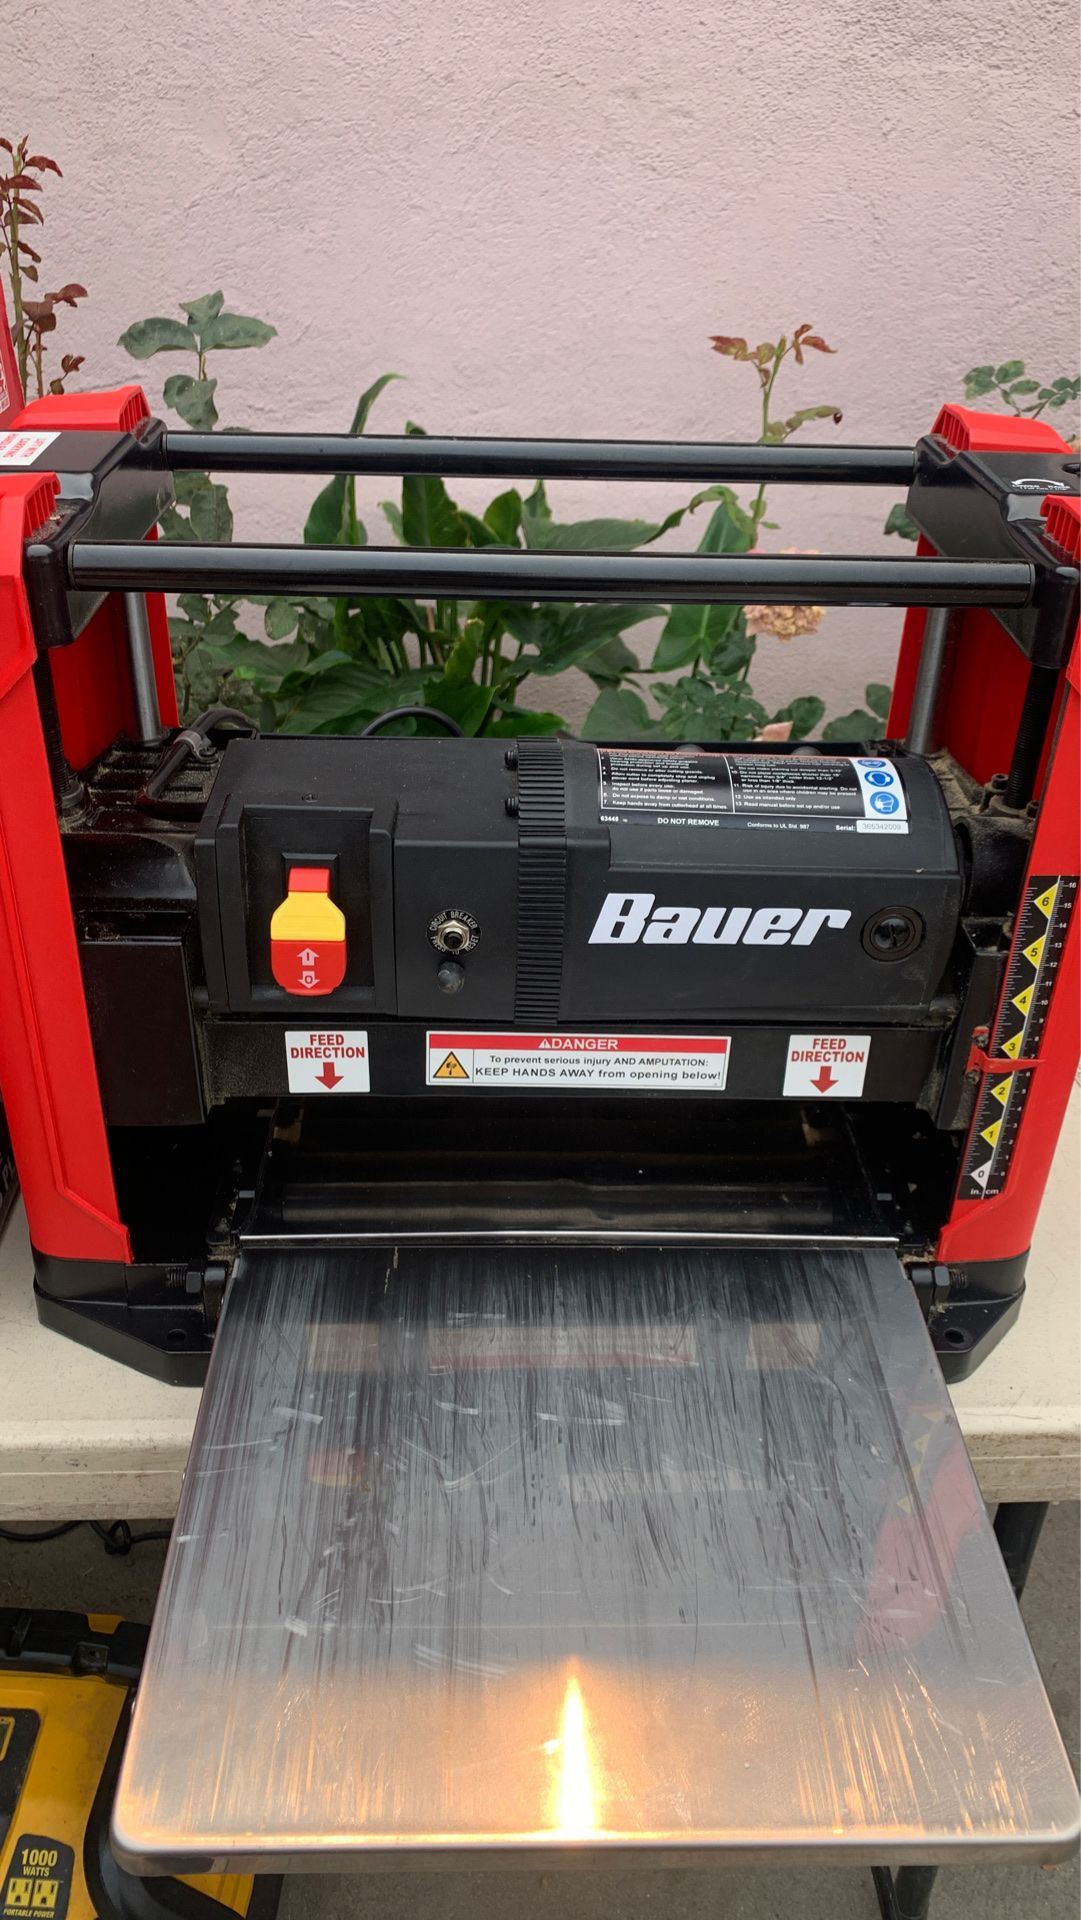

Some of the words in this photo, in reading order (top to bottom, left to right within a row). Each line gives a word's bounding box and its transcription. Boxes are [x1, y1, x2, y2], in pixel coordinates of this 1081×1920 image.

[1042, 897, 1050, 906] 6
[588, 893, 852, 946] Bauer
[1031, 947, 1038, 957] 5
[1020, 996, 1027, 1004] 4
[310, 1034, 344, 1046] FEED
[551, 1038, 618, 1050] DANGER
[812, 1038, 847, 1049] FEED
[290, 1047, 365, 1058] DIRECTION
[1009, 1043, 1016, 1051] 3
[504, 1056, 541, 1064] prevent
[544, 1056, 580, 1064] serious
[584, 1057, 611, 1066] injury
[639, 1058, 709, 1066] AMPUTATION:
[791, 1051, 864, 1062] DIRECTION
[475, 1068, 508, 1076] KEEP
[513, 1068, 556, 1077] HANDS
[560, 1068, 594, 1077] AWAY
[599, 1069, 625, 1078] from
[630, 1070, 678, 1080] opening
[682, 1071, 720, 1080] below!
[998, 1087, 1005, 1095] 2
[22, 1848, 58, 1867] 1000
[23, 1866, 50, 1877] WATTS
[3, 1908, 32, 1917] PORTABLE
